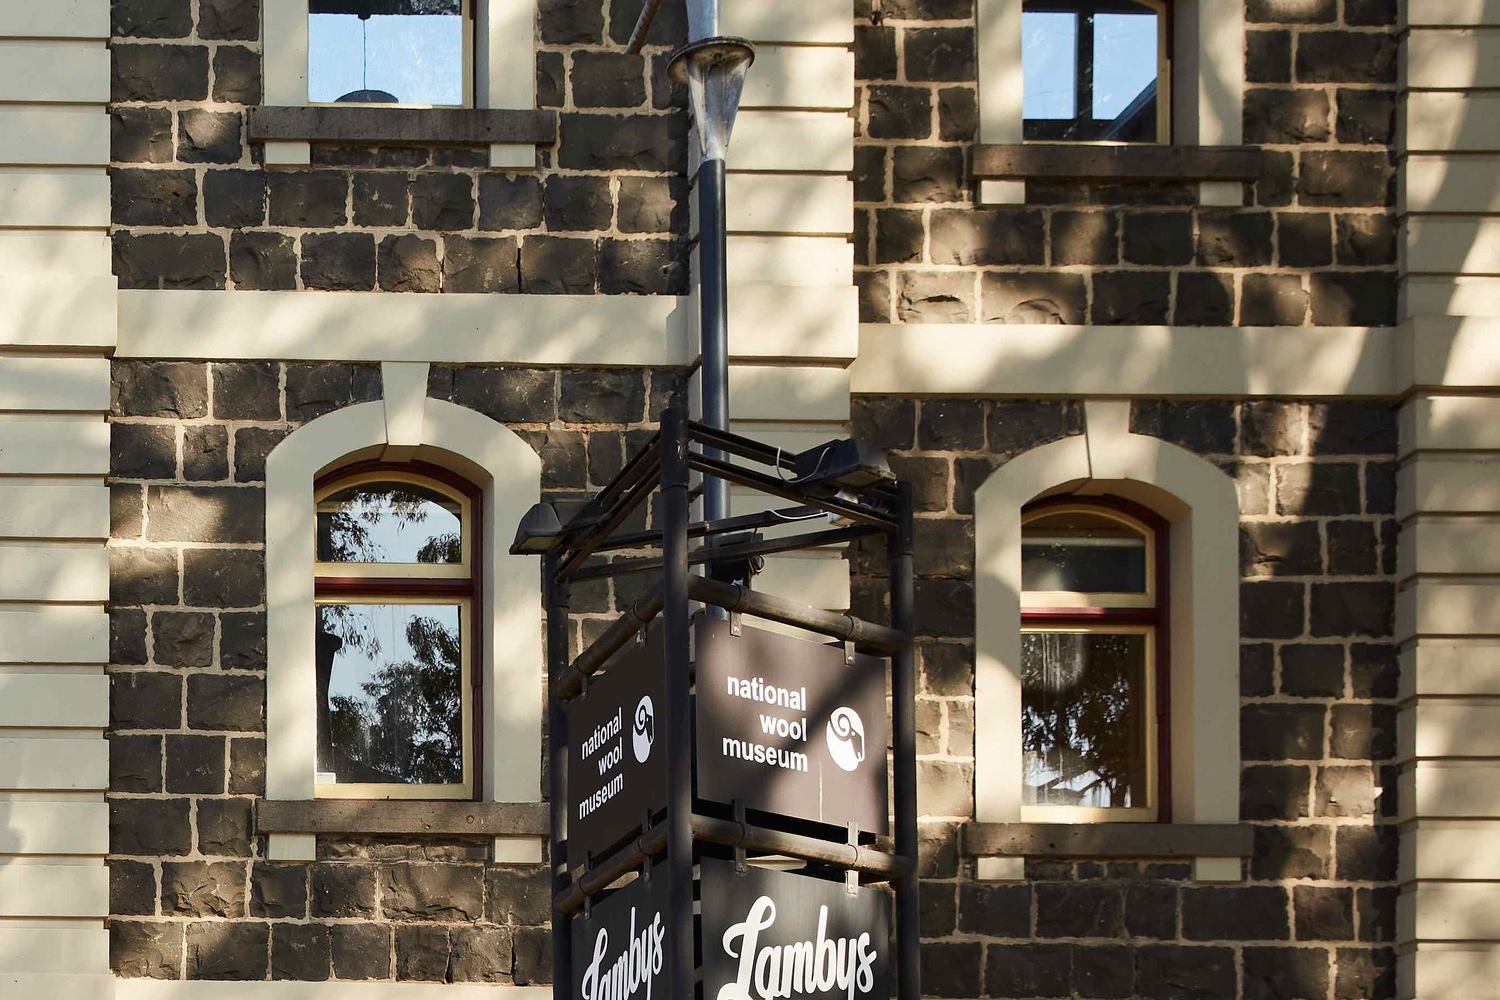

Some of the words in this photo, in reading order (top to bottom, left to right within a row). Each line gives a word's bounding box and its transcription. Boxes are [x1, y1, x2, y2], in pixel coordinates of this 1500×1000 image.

[726, 675, 807, 712] national
[581, 706, 623, 760] national
[759, 713, 808, 742] wool
[598, 736, 623, 776] wool
[722, 737, 809, 773] museum
[579, 772, 624, 820] museum
